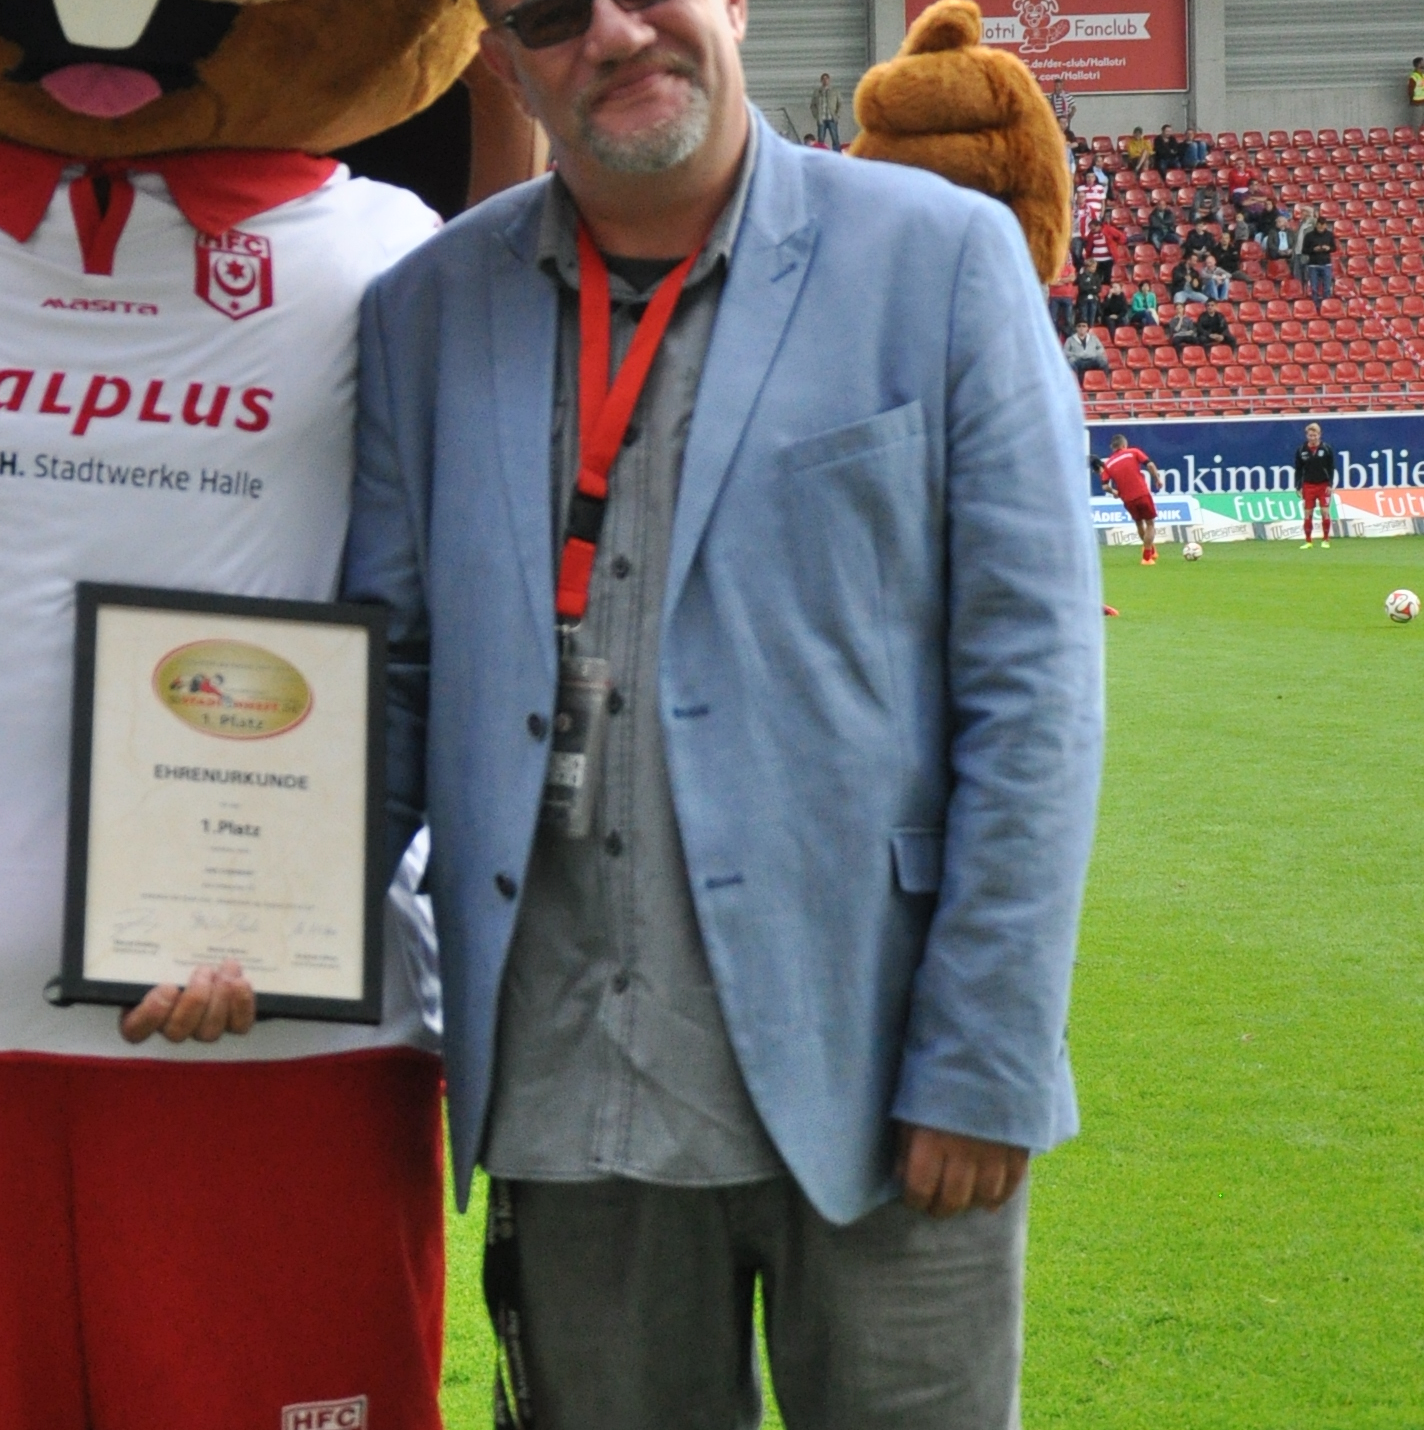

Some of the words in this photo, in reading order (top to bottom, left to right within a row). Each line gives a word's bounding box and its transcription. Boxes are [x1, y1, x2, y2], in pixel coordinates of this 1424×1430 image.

[1076, 18, 1138, 37] Fanclub
[34, 452, 191, 491] Stadtwerke
[200, 470, 263, 499] Halle
[153, 763, 310, 791] EHRENURKUNDE
